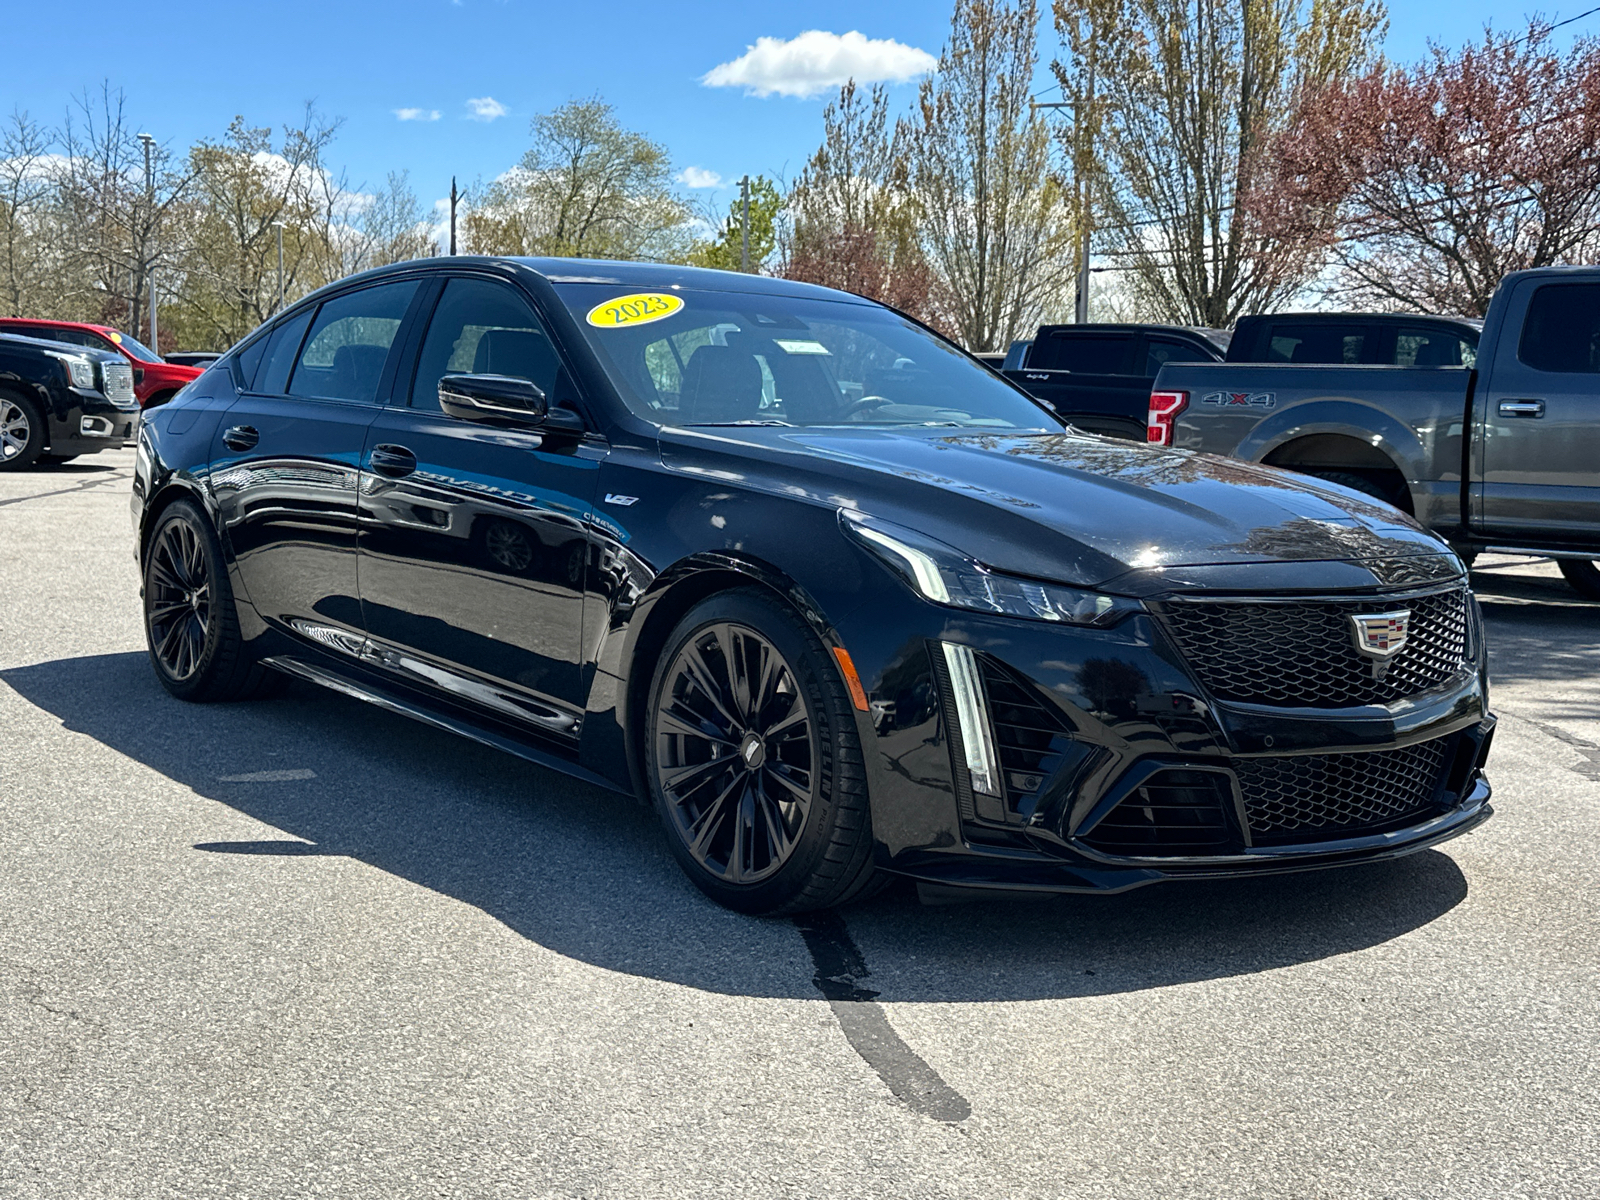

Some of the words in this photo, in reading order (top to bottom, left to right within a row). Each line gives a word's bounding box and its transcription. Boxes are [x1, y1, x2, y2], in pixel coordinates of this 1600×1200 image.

[605, 296, 669, 324] 2023
[808, 682, 833, 801] MICHELIN
[816, 807, 828, 838] PILOT
